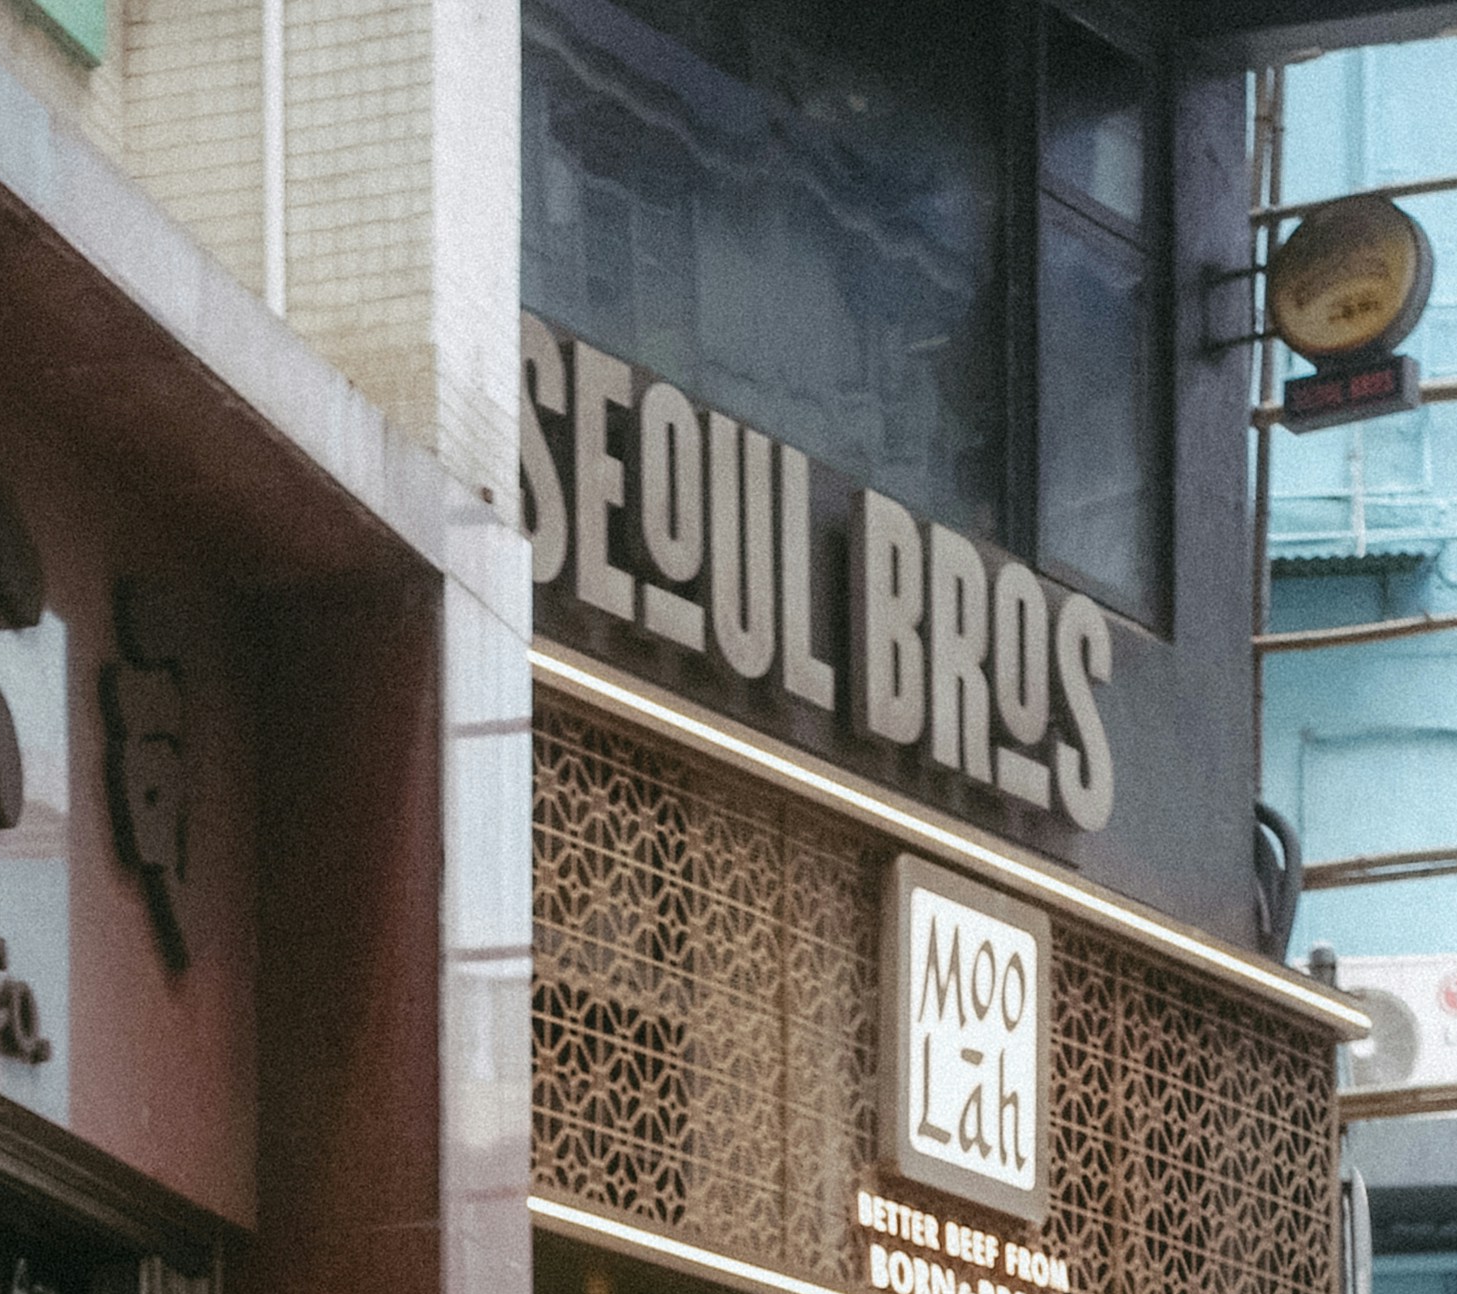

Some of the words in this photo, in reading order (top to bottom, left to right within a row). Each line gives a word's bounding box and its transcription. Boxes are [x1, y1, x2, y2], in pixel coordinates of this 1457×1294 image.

[519, 314, 835, 712] SEOUL
[865, 487, 1115, 833] BROS
[857, 1190, 941, 1250] BETTER
[944, 1215, 1000, 1264] BEEF
[1004, 1236, 1071, 1292] FROM
